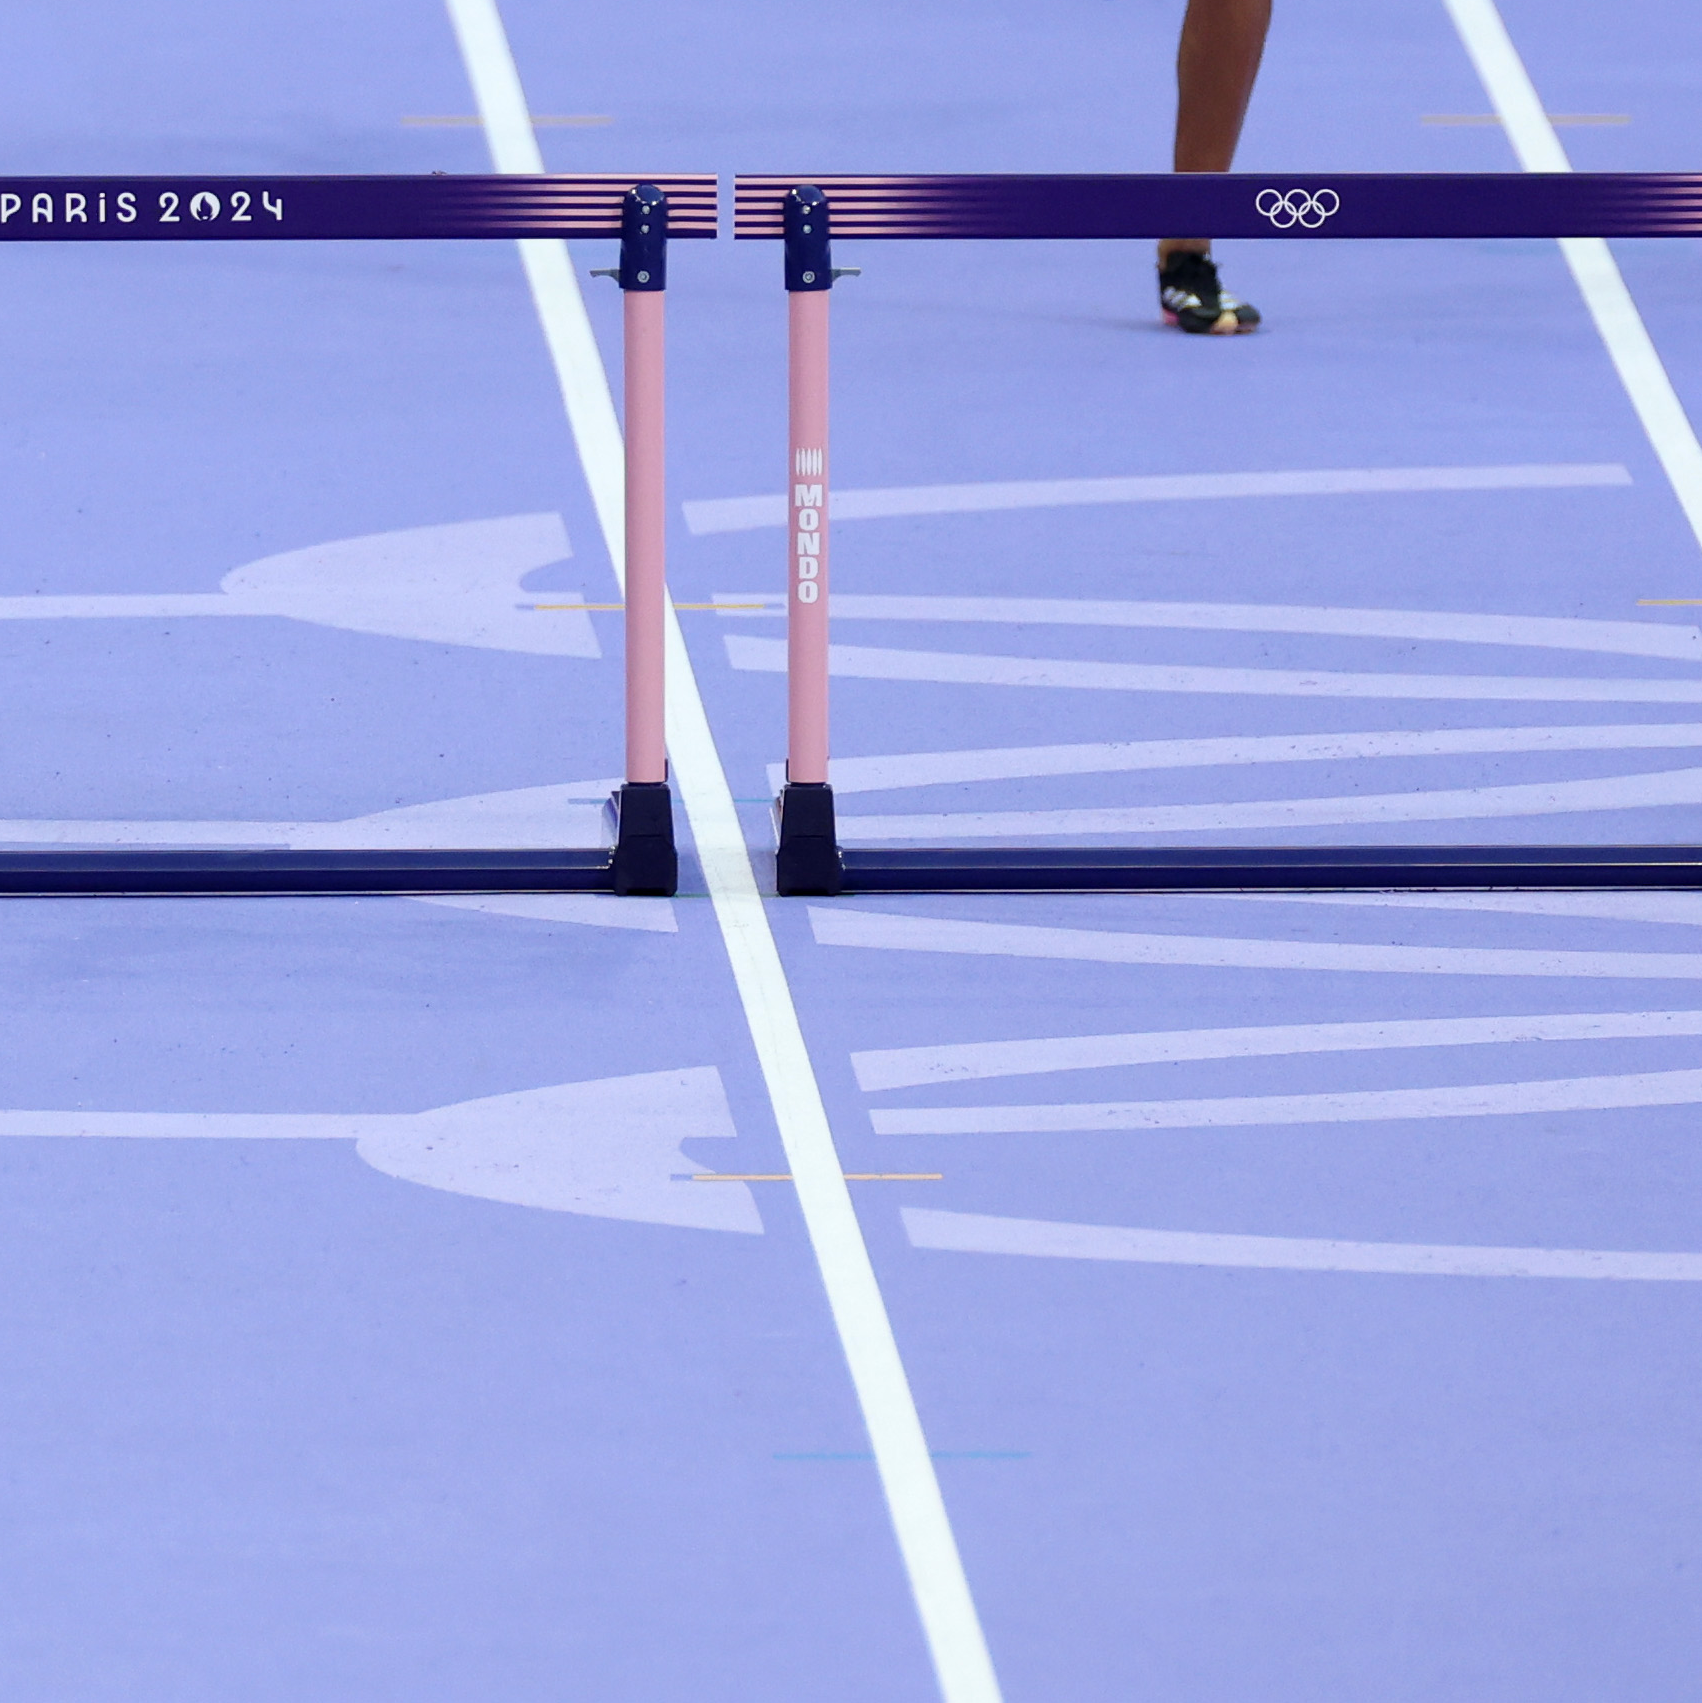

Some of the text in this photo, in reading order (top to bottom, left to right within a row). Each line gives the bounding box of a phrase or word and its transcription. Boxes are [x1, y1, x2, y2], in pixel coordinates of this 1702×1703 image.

[0, 190, 283, 224] PARIS 2024
[795, 483, 823, 604] MONDO
